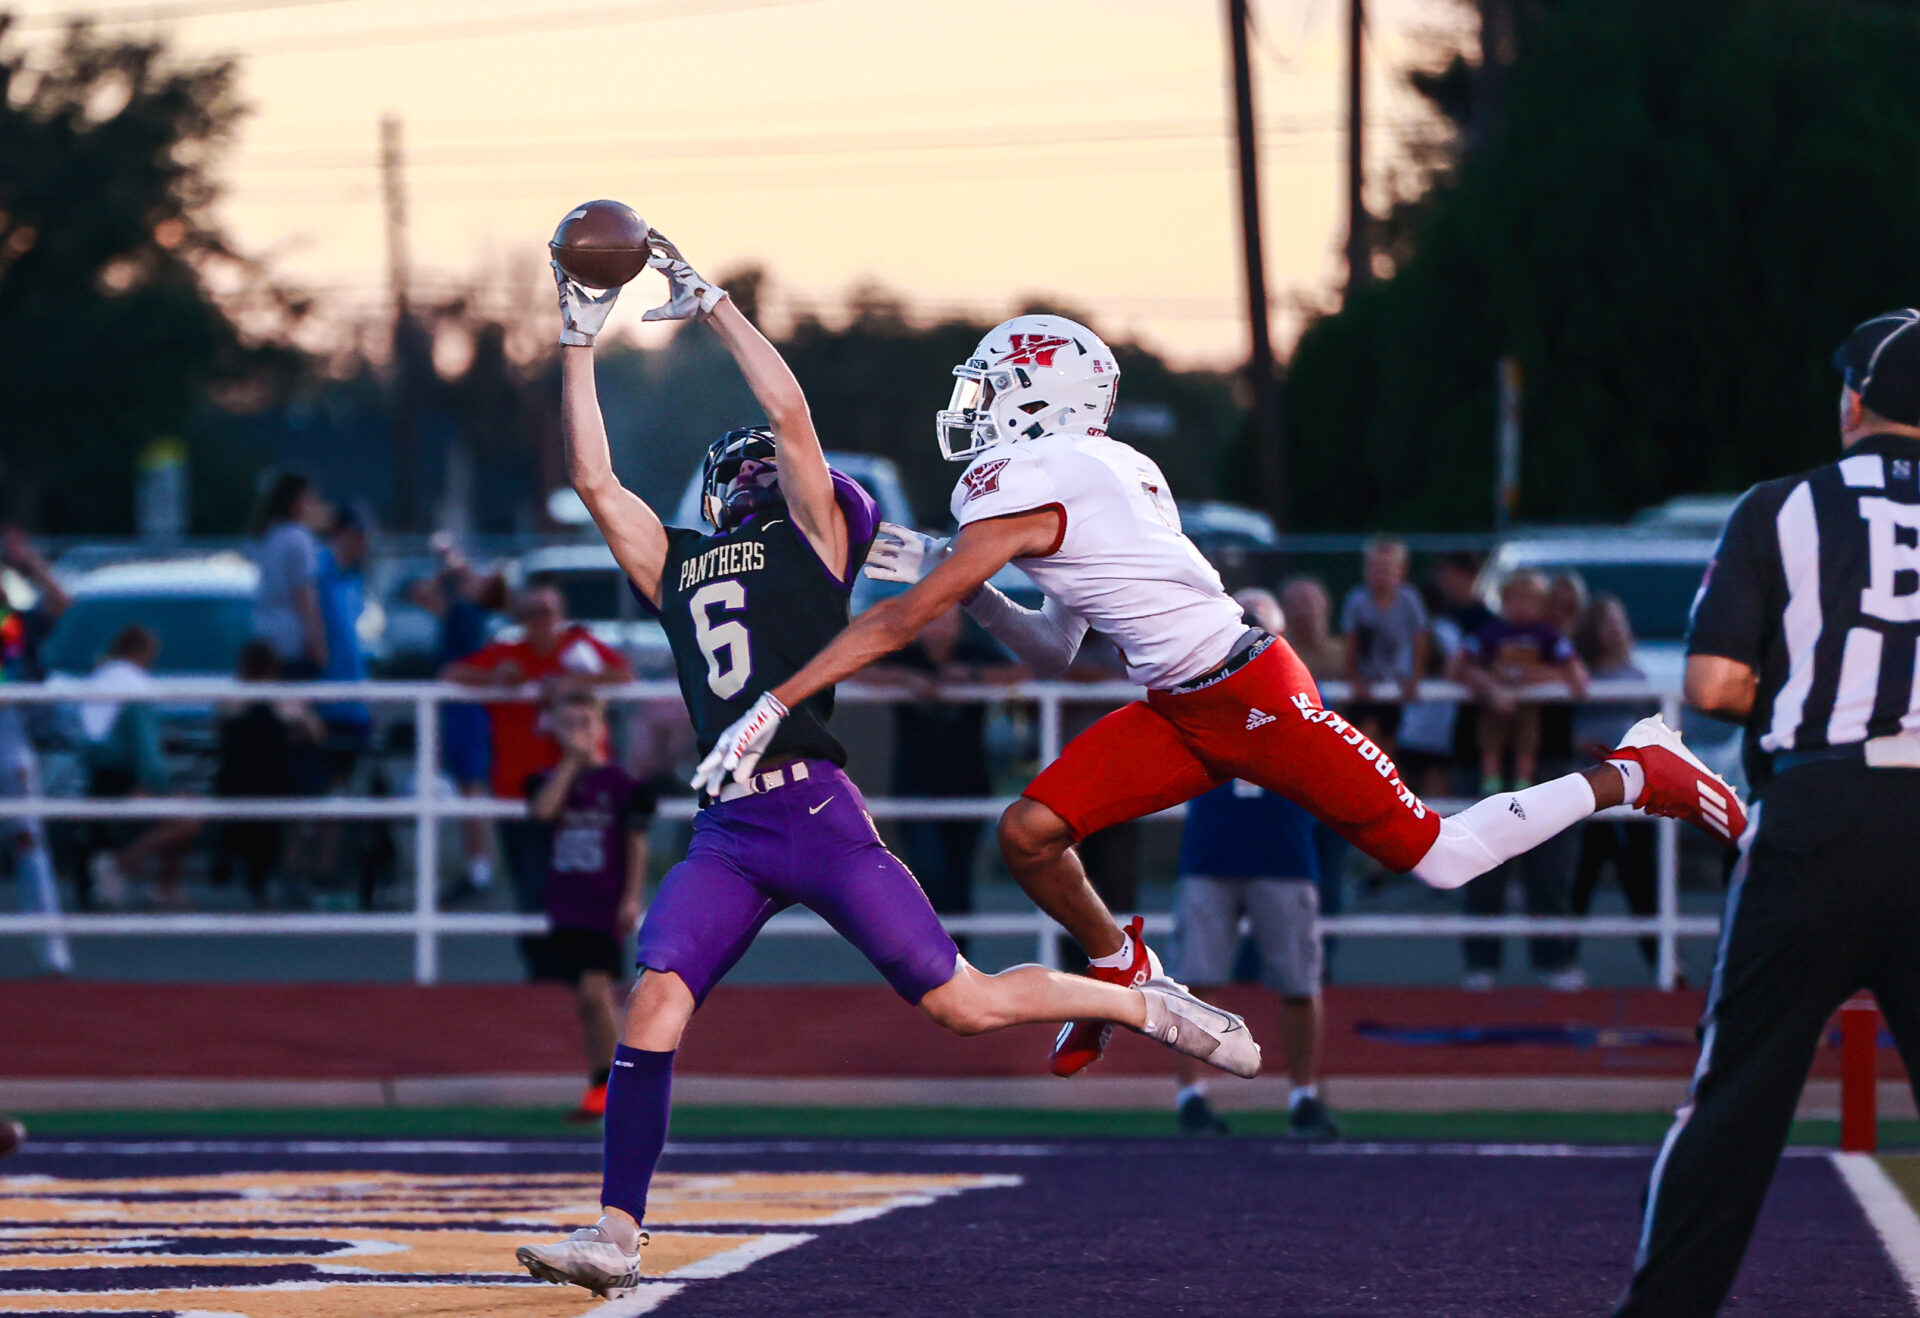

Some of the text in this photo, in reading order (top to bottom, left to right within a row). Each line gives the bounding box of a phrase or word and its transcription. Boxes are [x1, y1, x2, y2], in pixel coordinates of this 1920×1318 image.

[678, 541, 765, 592] PANTHERS
[1857, 495, 1920, 622] B
[689, 577, 754, 701] 6
